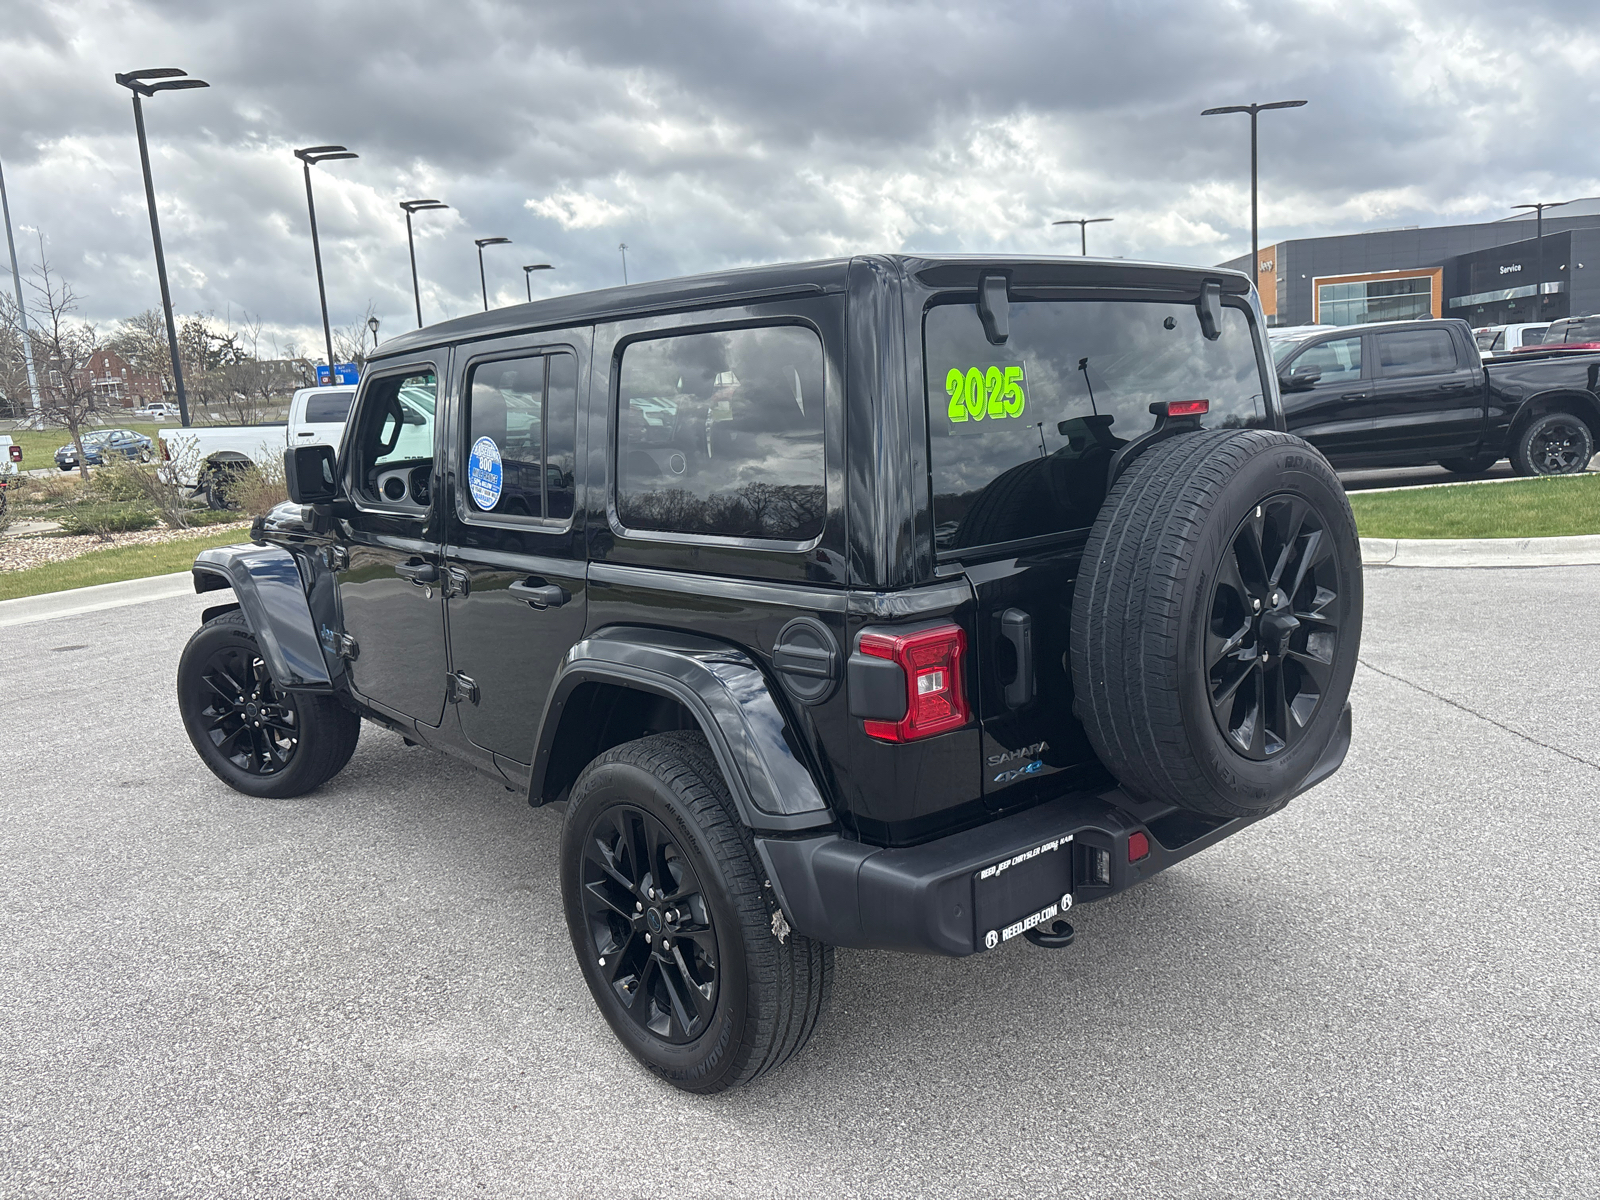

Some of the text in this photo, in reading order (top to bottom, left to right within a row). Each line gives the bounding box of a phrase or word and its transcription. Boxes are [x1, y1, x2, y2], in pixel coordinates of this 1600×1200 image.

[1259, 260, 1273, 272] Jeep
[1499, 263, 1521, 274] Service
[946, 366, 1025, 422] 2025
[479, 457, 492, 472] 800
[321, 623, 334, 641] Jee
[987, 741, 1050, 767] SAHARA
[664, 802, 703, 857] All-Weather
[980, 866, 997, 880] REED
[997, 859, 1012, 873] JEEP
[1012, 847, 1041, 866] CHRYSLER
[1059, 834, 1074, 845] RAM
[1002, 904, 1058, 942] REEDJEEP.COM
